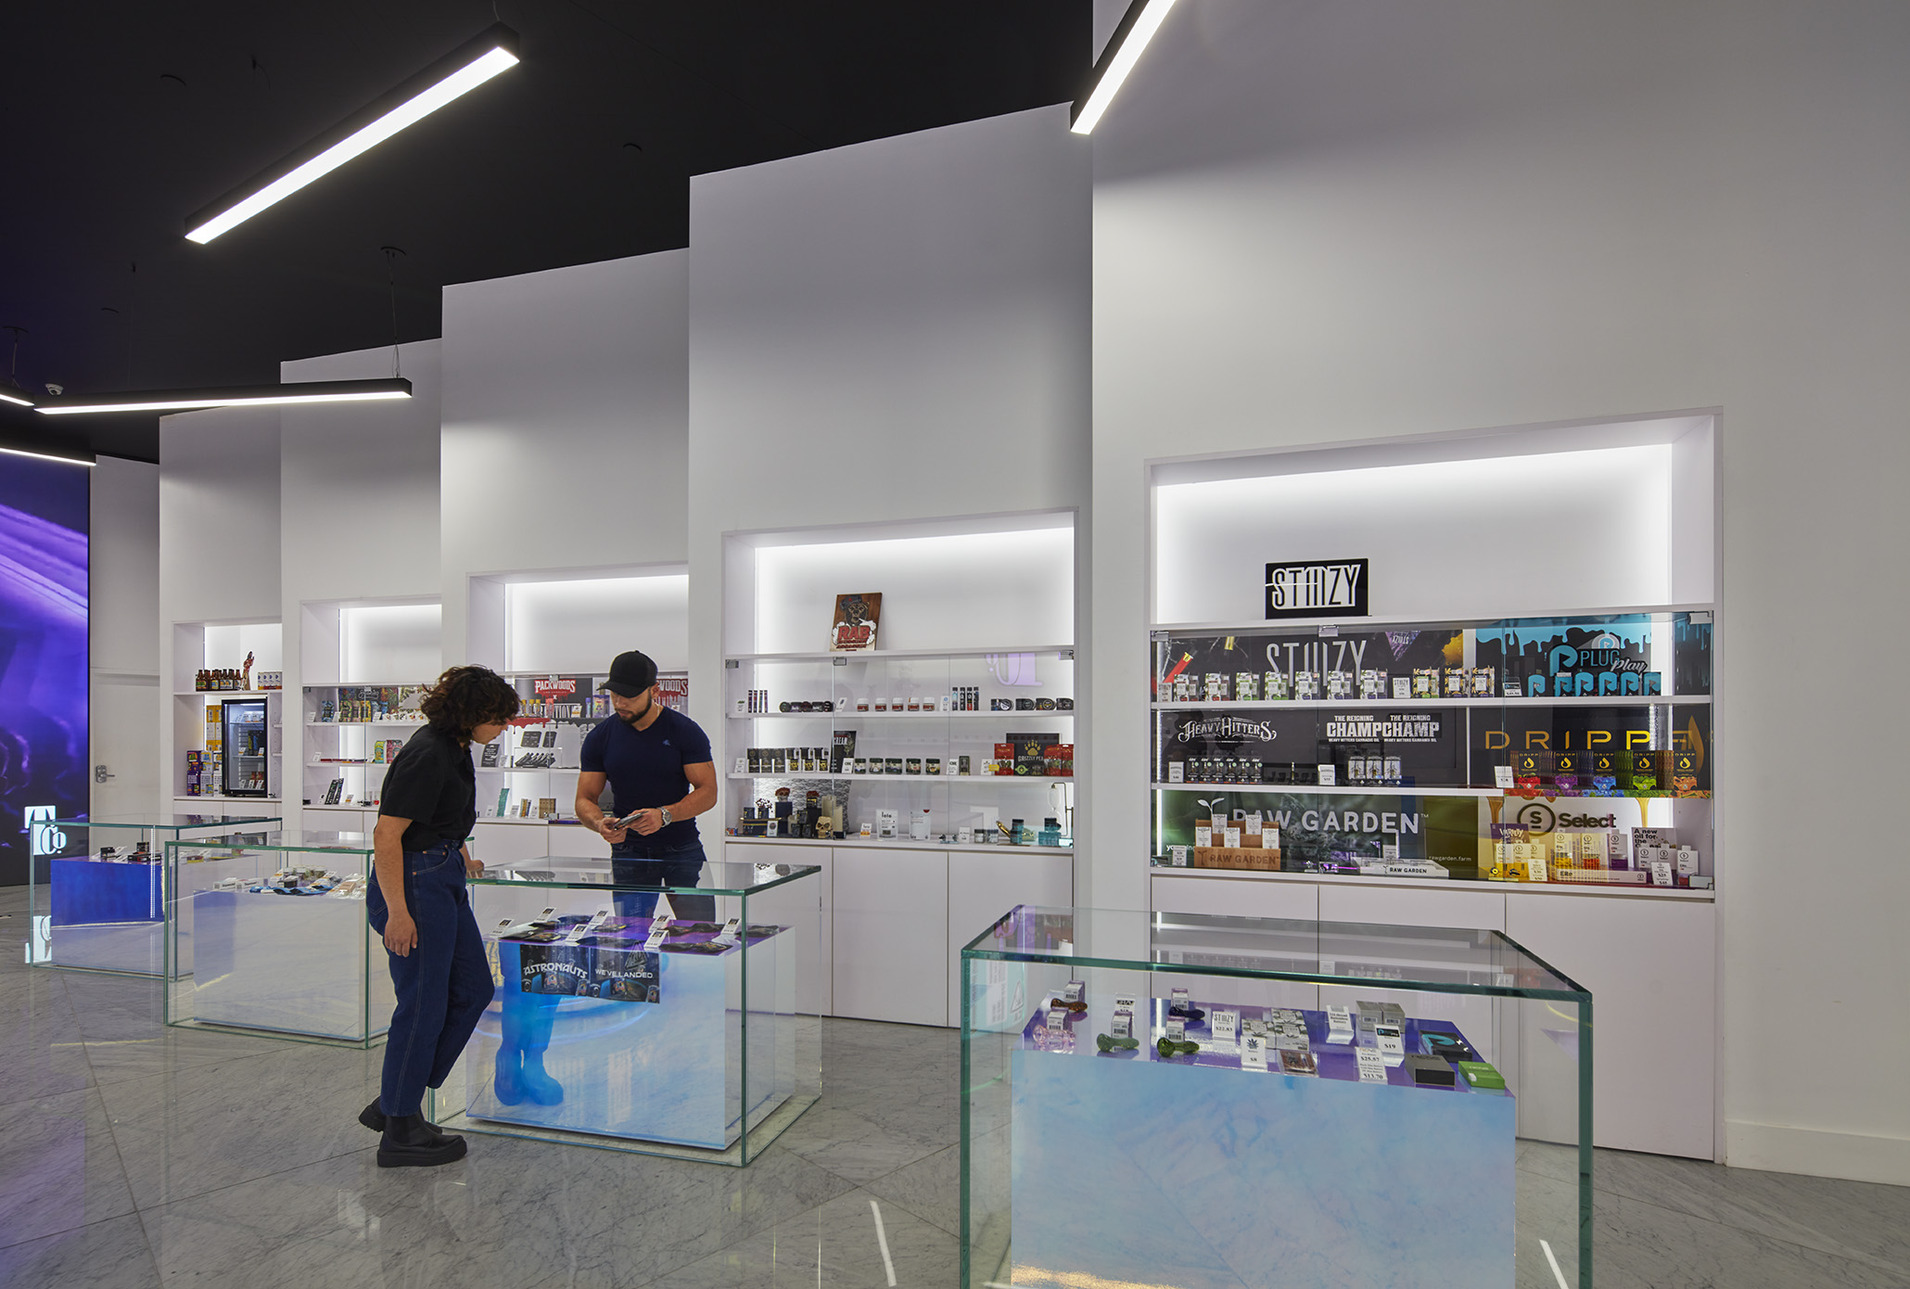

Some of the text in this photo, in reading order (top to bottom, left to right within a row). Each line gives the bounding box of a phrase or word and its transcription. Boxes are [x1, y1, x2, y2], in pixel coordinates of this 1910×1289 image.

[1580, 649, 1620, 667] PLUG
[1326, 722, 1382, 738] CHAMP
[1382, 722, 1440, 738] CHAMP
[1301, 810, 1419, 834] GARDEN
[1558, 812, 1617, 828] Select
[1209, 854, 1276, 865] RAW GARDEN
[523, 962, 588, 979] ASTRONAUTS
